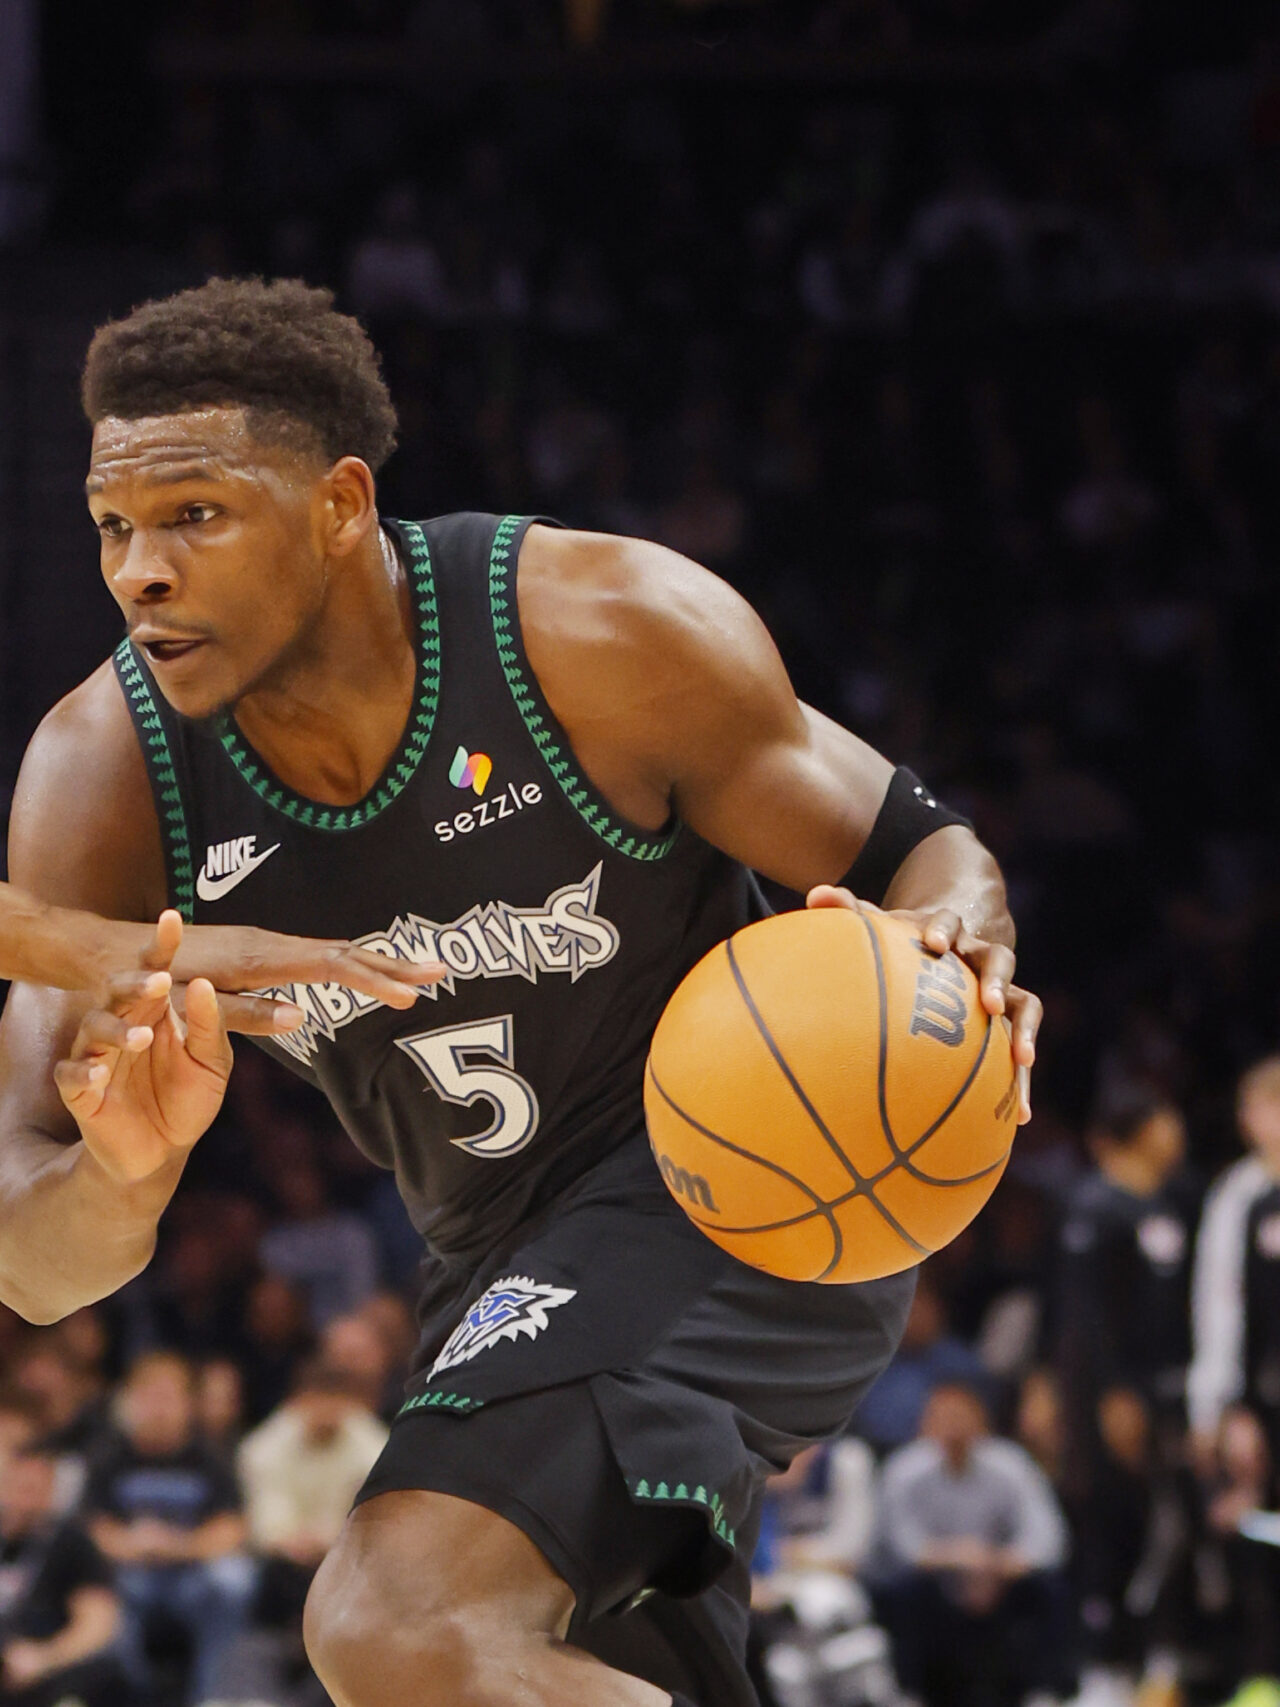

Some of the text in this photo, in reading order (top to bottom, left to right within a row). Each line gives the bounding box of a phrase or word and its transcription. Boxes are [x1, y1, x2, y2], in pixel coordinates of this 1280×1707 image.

[434, 781, 543, 843] sezzle
[206, 835, 257, 878] NIKE
[394, 1014, 540, 1159] 5
